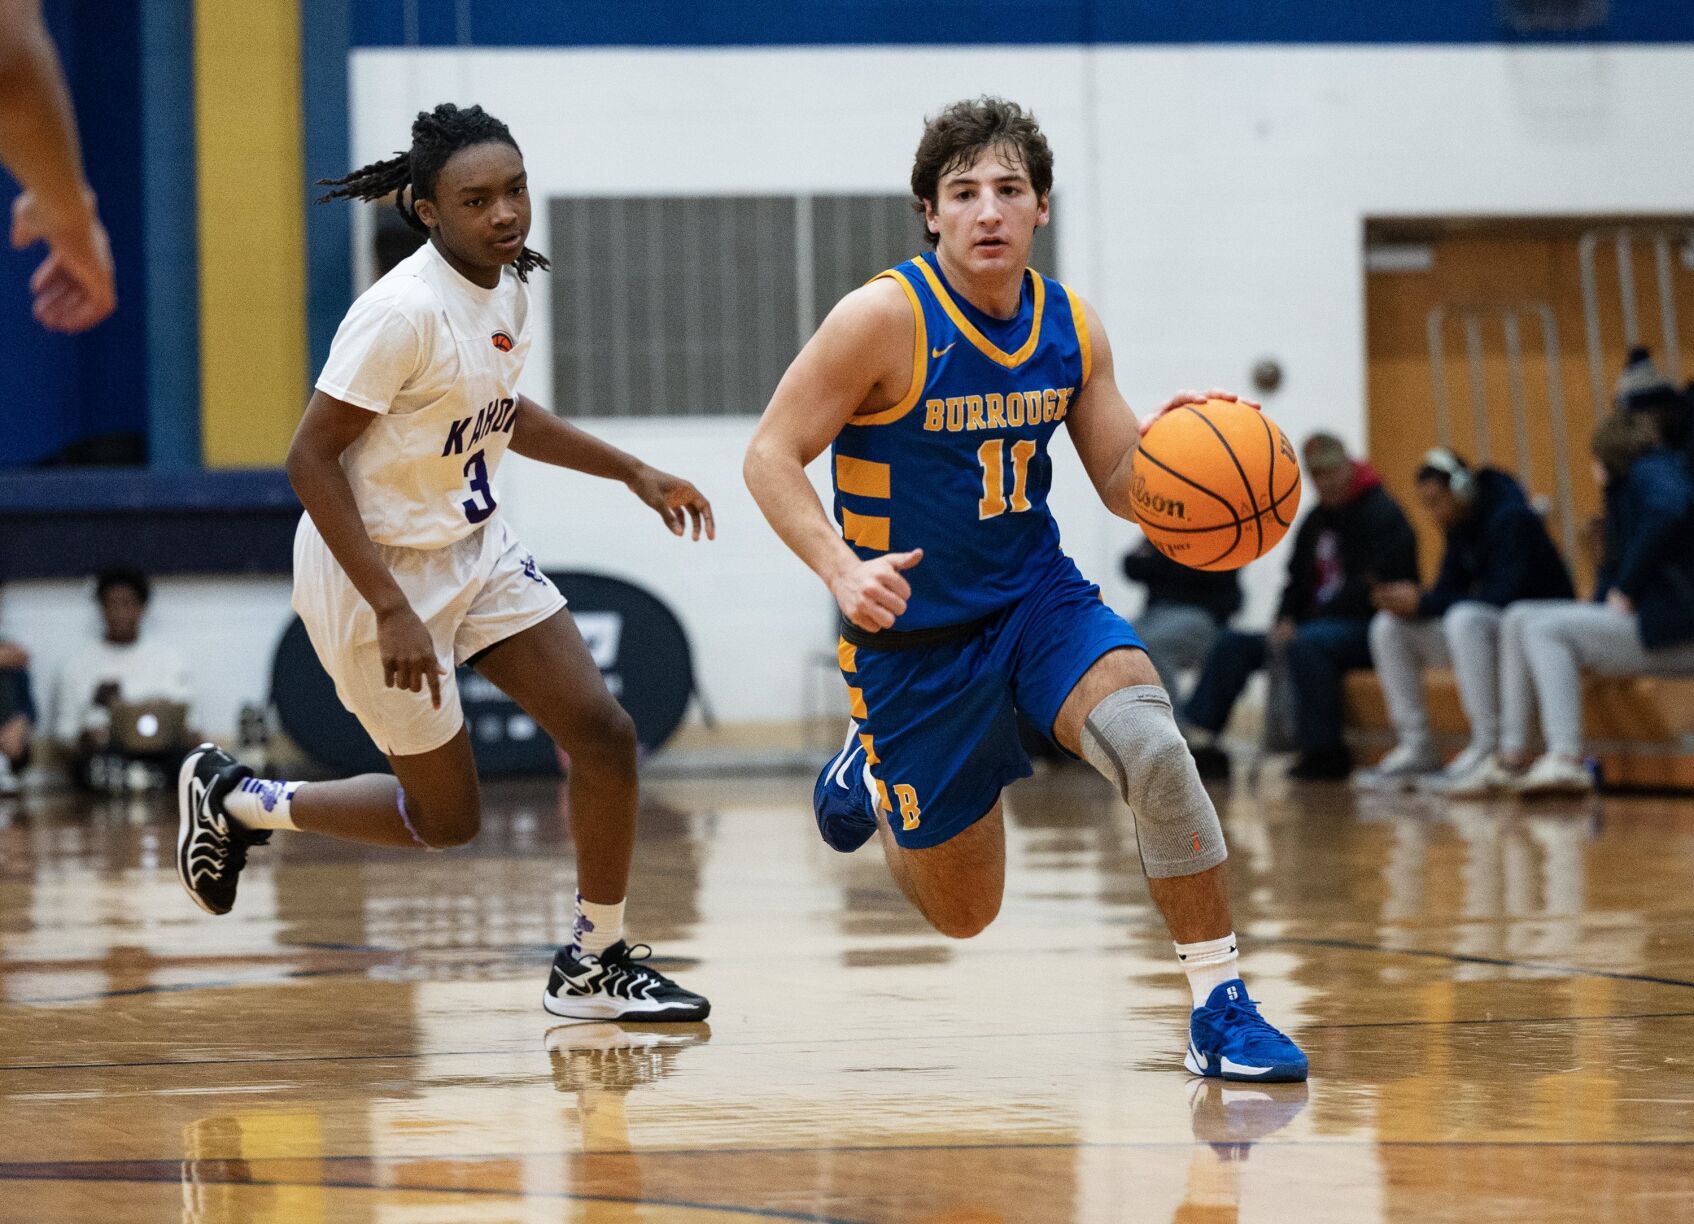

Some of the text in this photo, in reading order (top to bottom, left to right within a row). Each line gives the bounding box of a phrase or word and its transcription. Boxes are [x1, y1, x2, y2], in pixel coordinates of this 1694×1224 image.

[462, 449, 496, 524] 3
[977, 439, 1036, 520] 11
[893, 784, 921, 830] B
